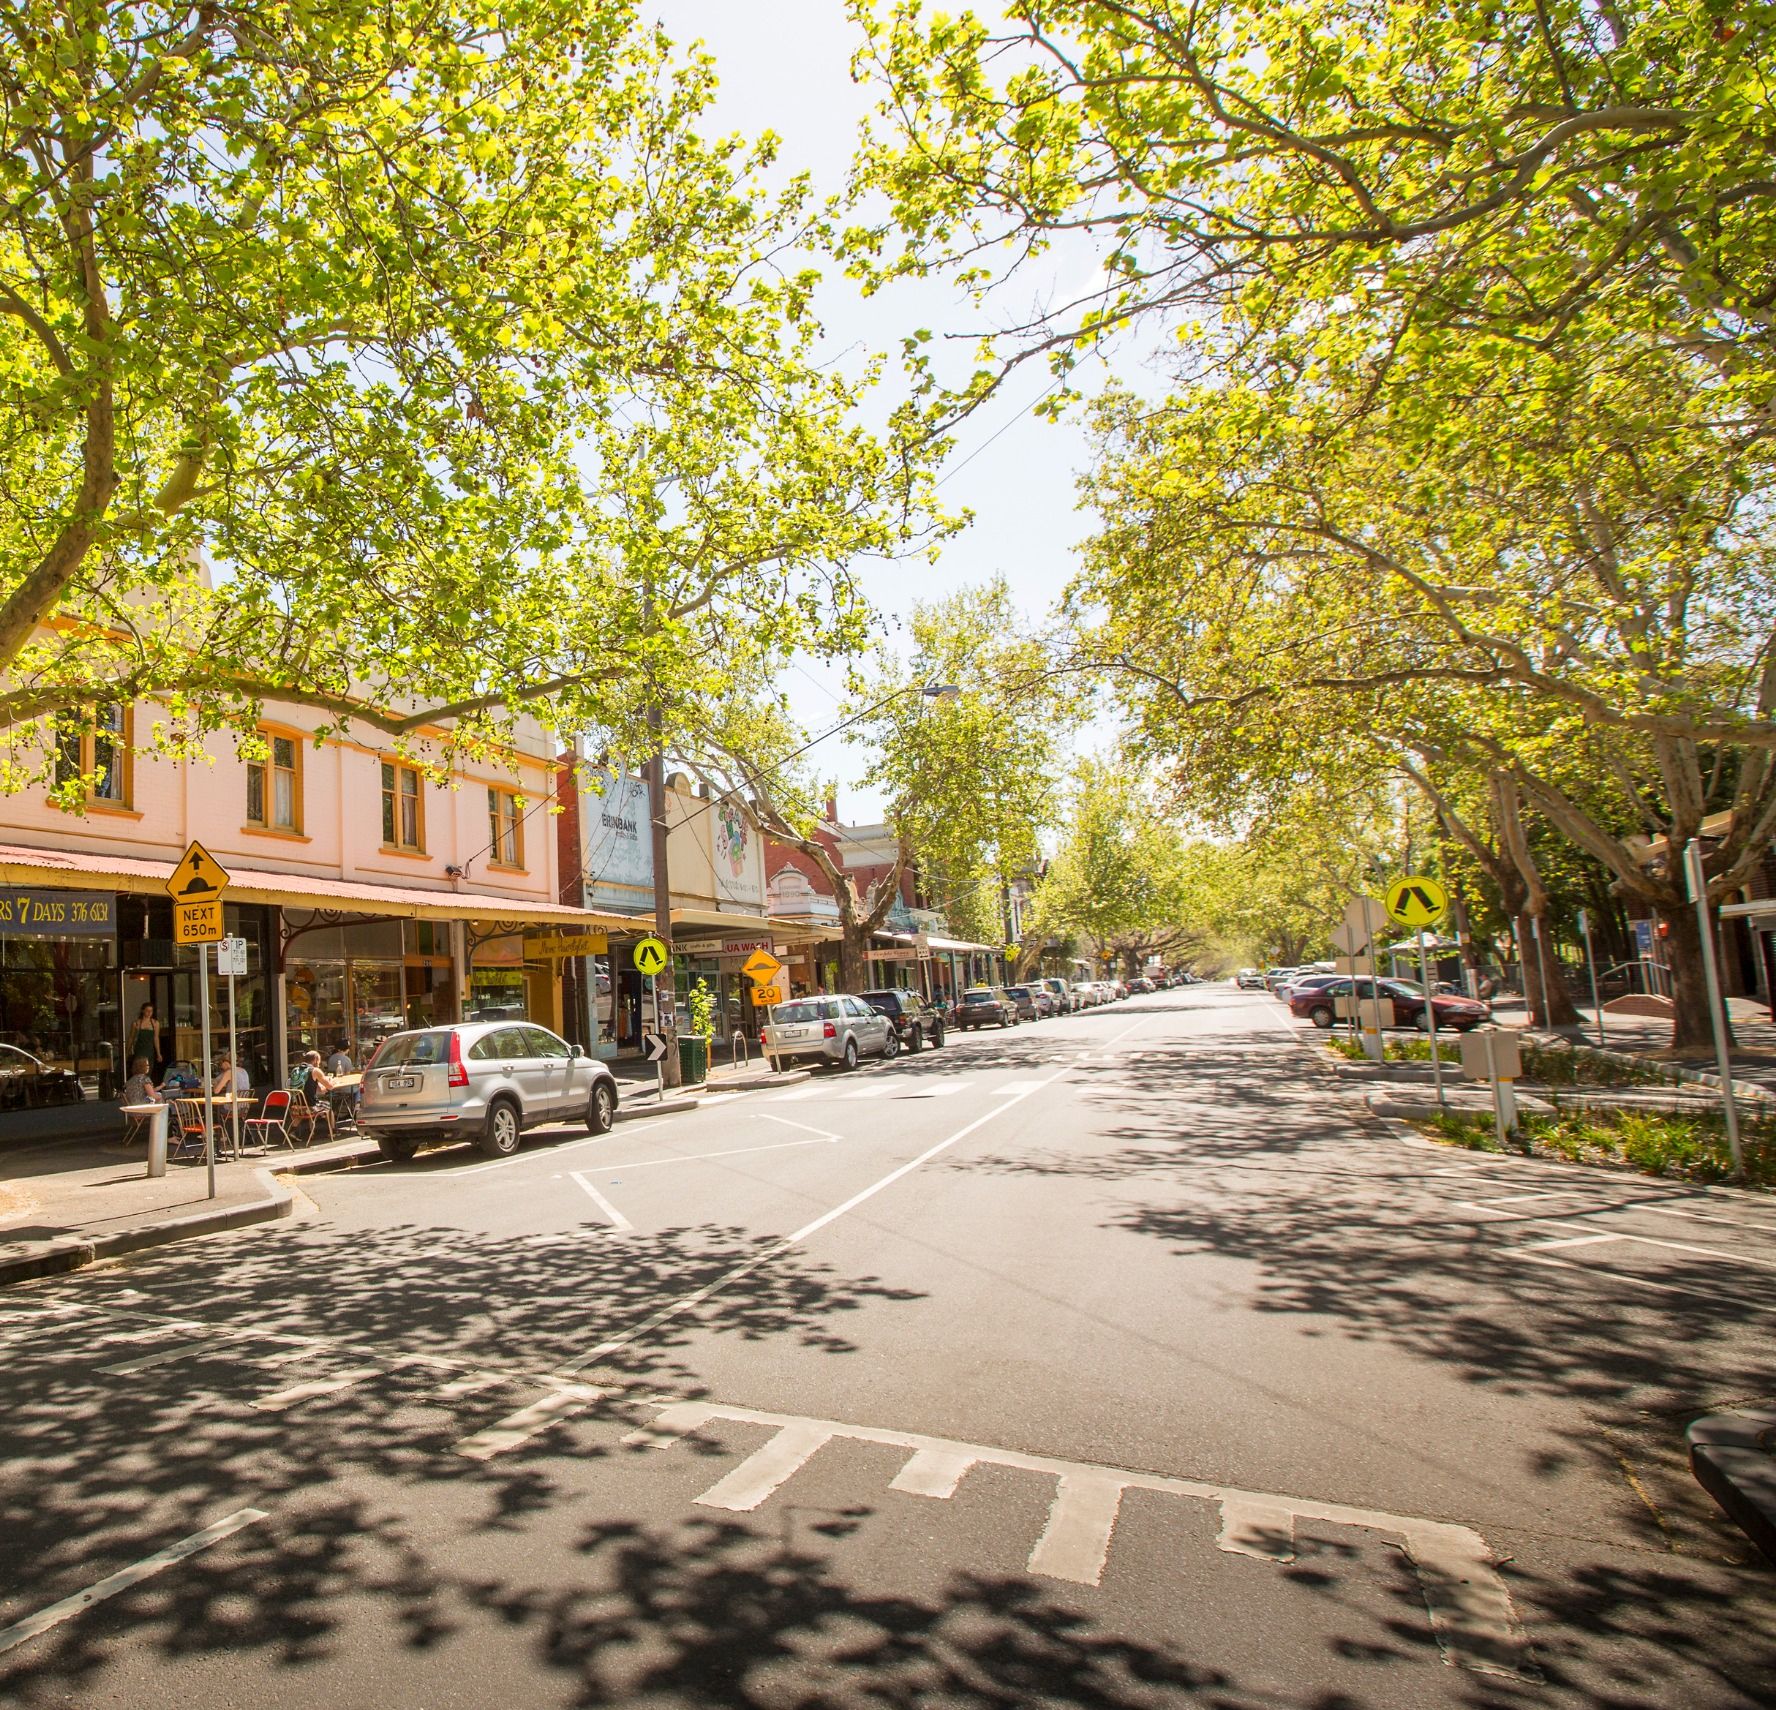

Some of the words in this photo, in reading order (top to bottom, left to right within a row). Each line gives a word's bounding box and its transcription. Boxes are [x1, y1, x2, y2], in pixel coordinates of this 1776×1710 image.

[17, 897, 30, 924] 7
[33, 902, 65, 921] DAYS
[71, 902, 87, 921] 376
[90, 902, 108, 921] 6131
[183, 907, 215, 921] NEXT
[183, 924, 216, 936] 650m
[758, 989, 774, 998] 20
